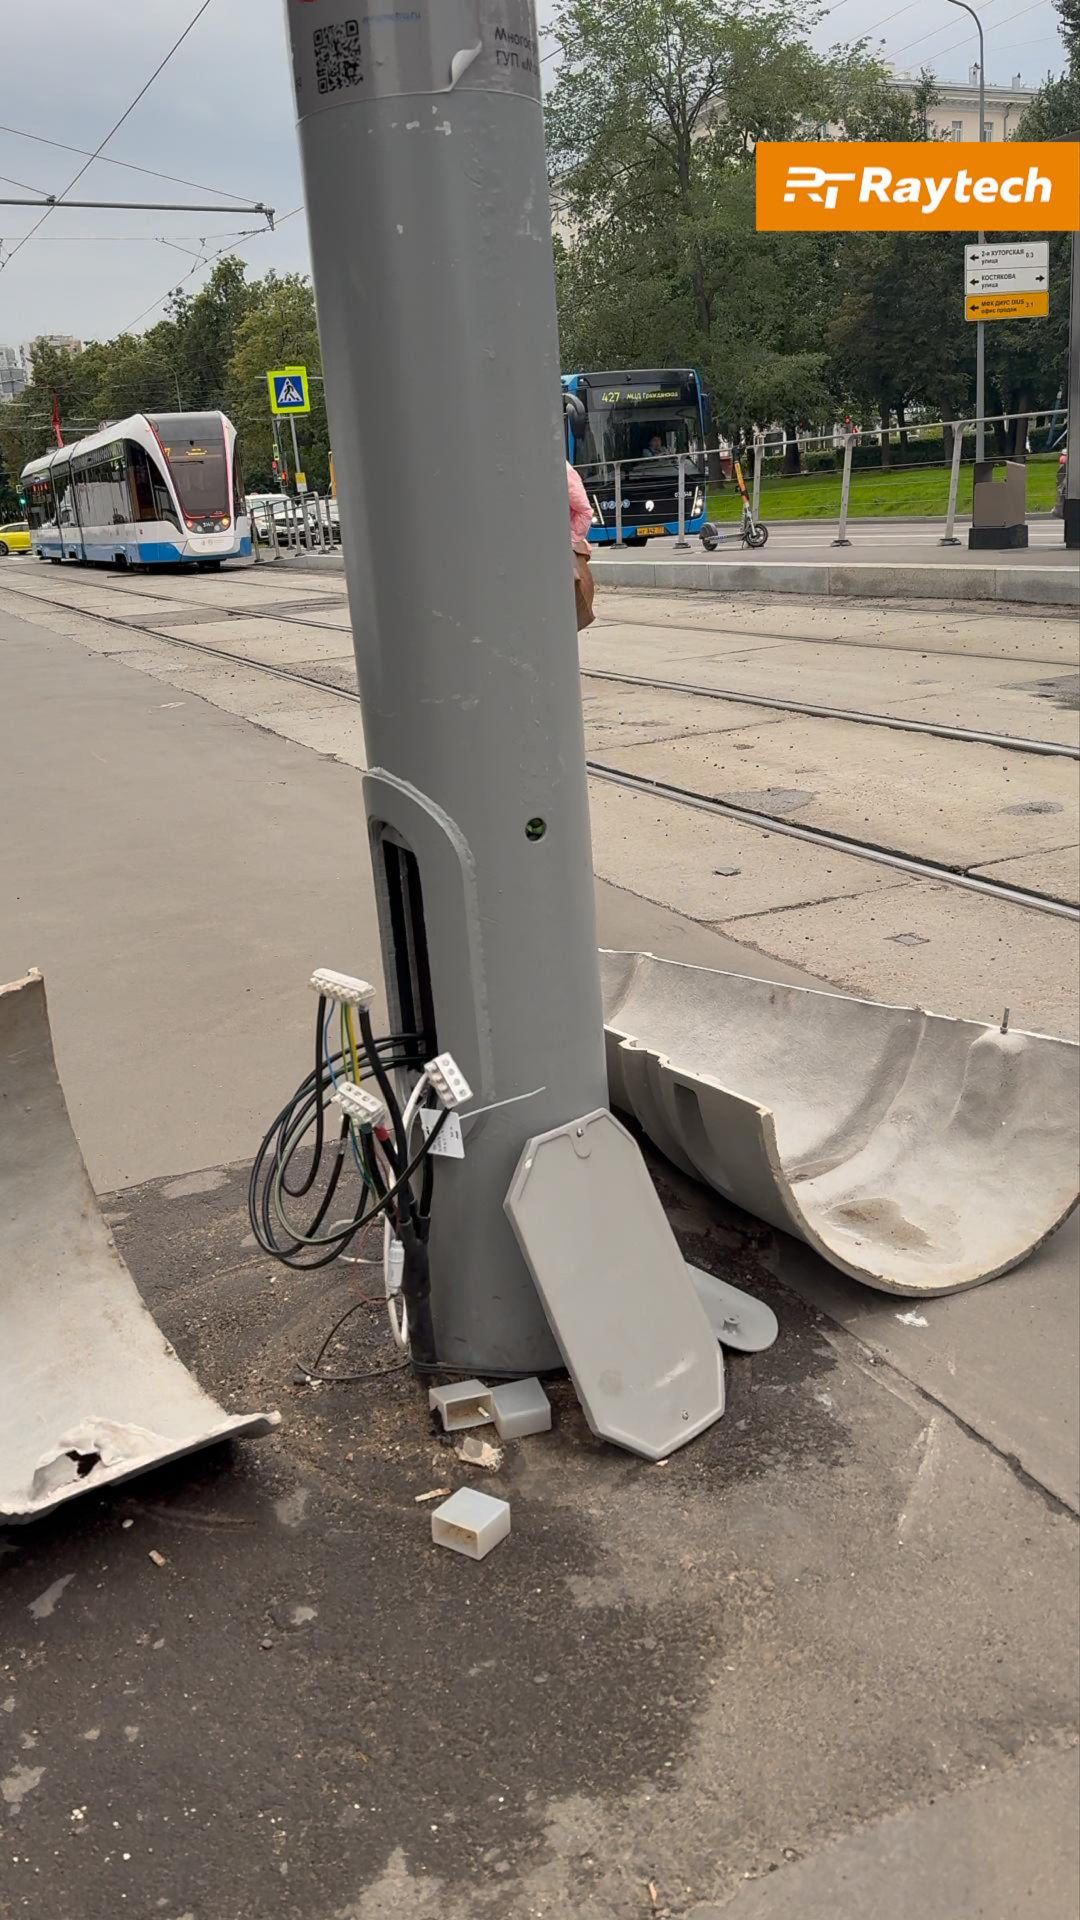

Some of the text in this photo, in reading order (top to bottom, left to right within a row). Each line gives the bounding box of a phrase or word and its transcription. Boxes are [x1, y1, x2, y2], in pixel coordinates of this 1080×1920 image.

[496, 50, 519, 68] ГУП
[981, 273, 1016, 281] КОСТЯКОВА
[601, 391, 621, 403] 427
